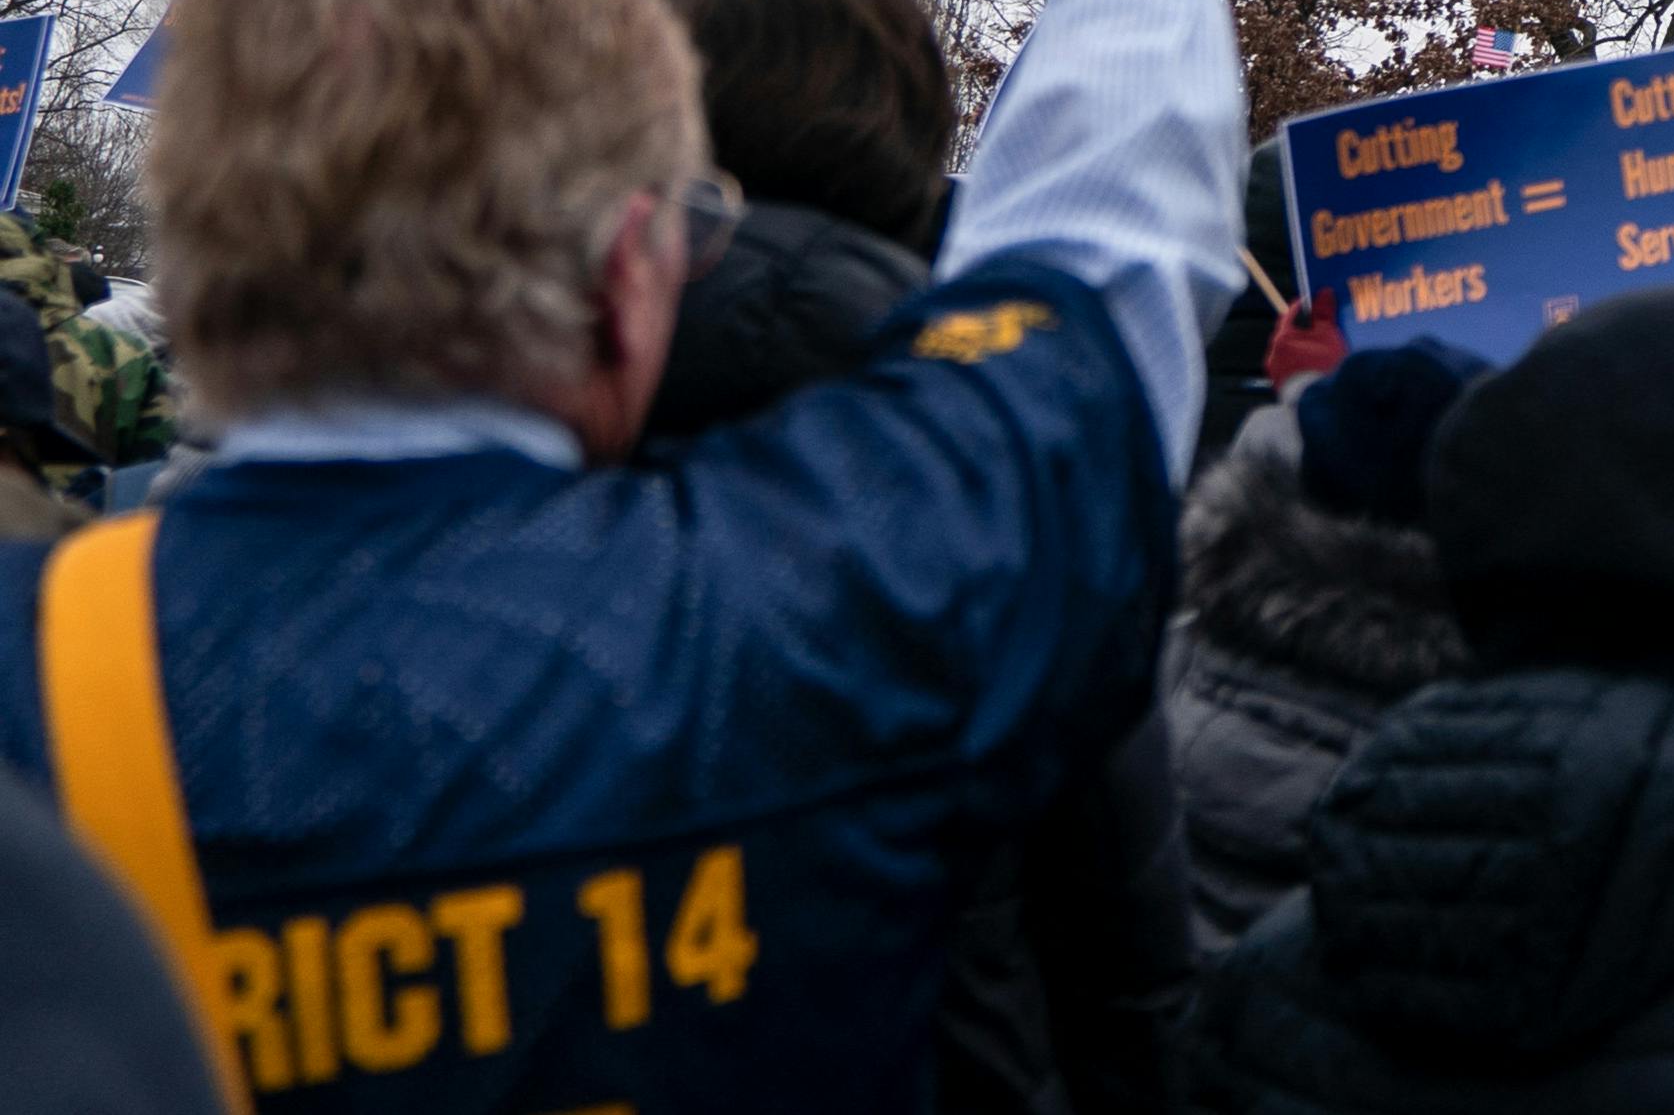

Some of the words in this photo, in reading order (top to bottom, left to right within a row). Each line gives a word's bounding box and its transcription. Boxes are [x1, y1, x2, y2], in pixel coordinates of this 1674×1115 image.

[1335, 118, 1465, 181] Cutting
[1310, 179, 1509, 260] Government
[1347, 263, 1488, 323] Workers
[206, 884, 526, 1088] RICT
[574, 843, 761, 1031] 14
